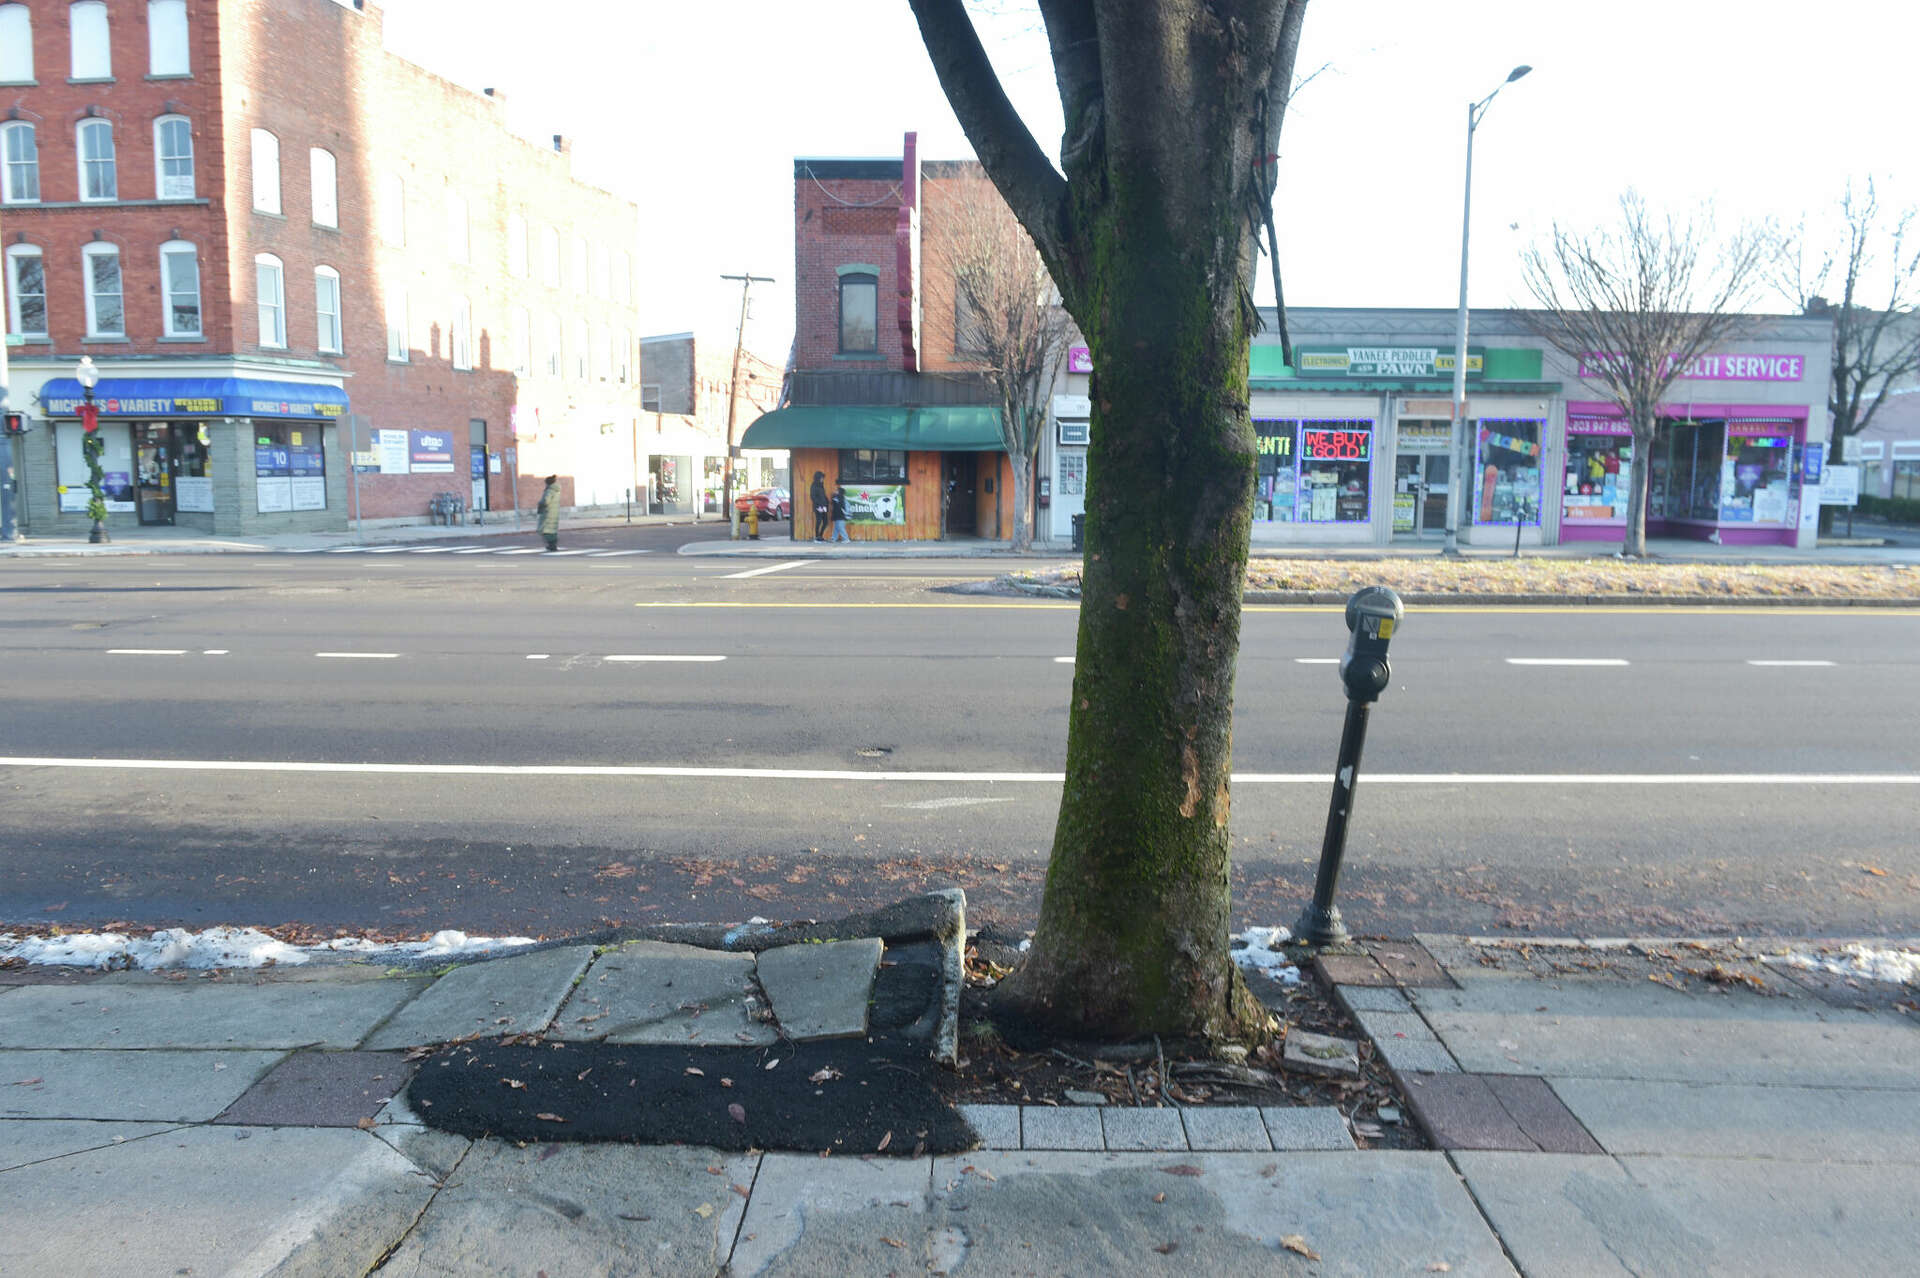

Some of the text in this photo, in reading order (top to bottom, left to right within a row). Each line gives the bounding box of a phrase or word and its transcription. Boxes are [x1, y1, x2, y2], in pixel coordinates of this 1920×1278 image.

[1352, 350, 1433, 362] YANKEE PEDDLER
[1376, 363, 1427, 375] PAWN
[1725, 356, 1801, 378] SERVICE
[120, 399, 171, 412] VARIETY
[1305, 431, 1367, 446] WE BUY
[1313, 444, 1360, 458] GOLD
